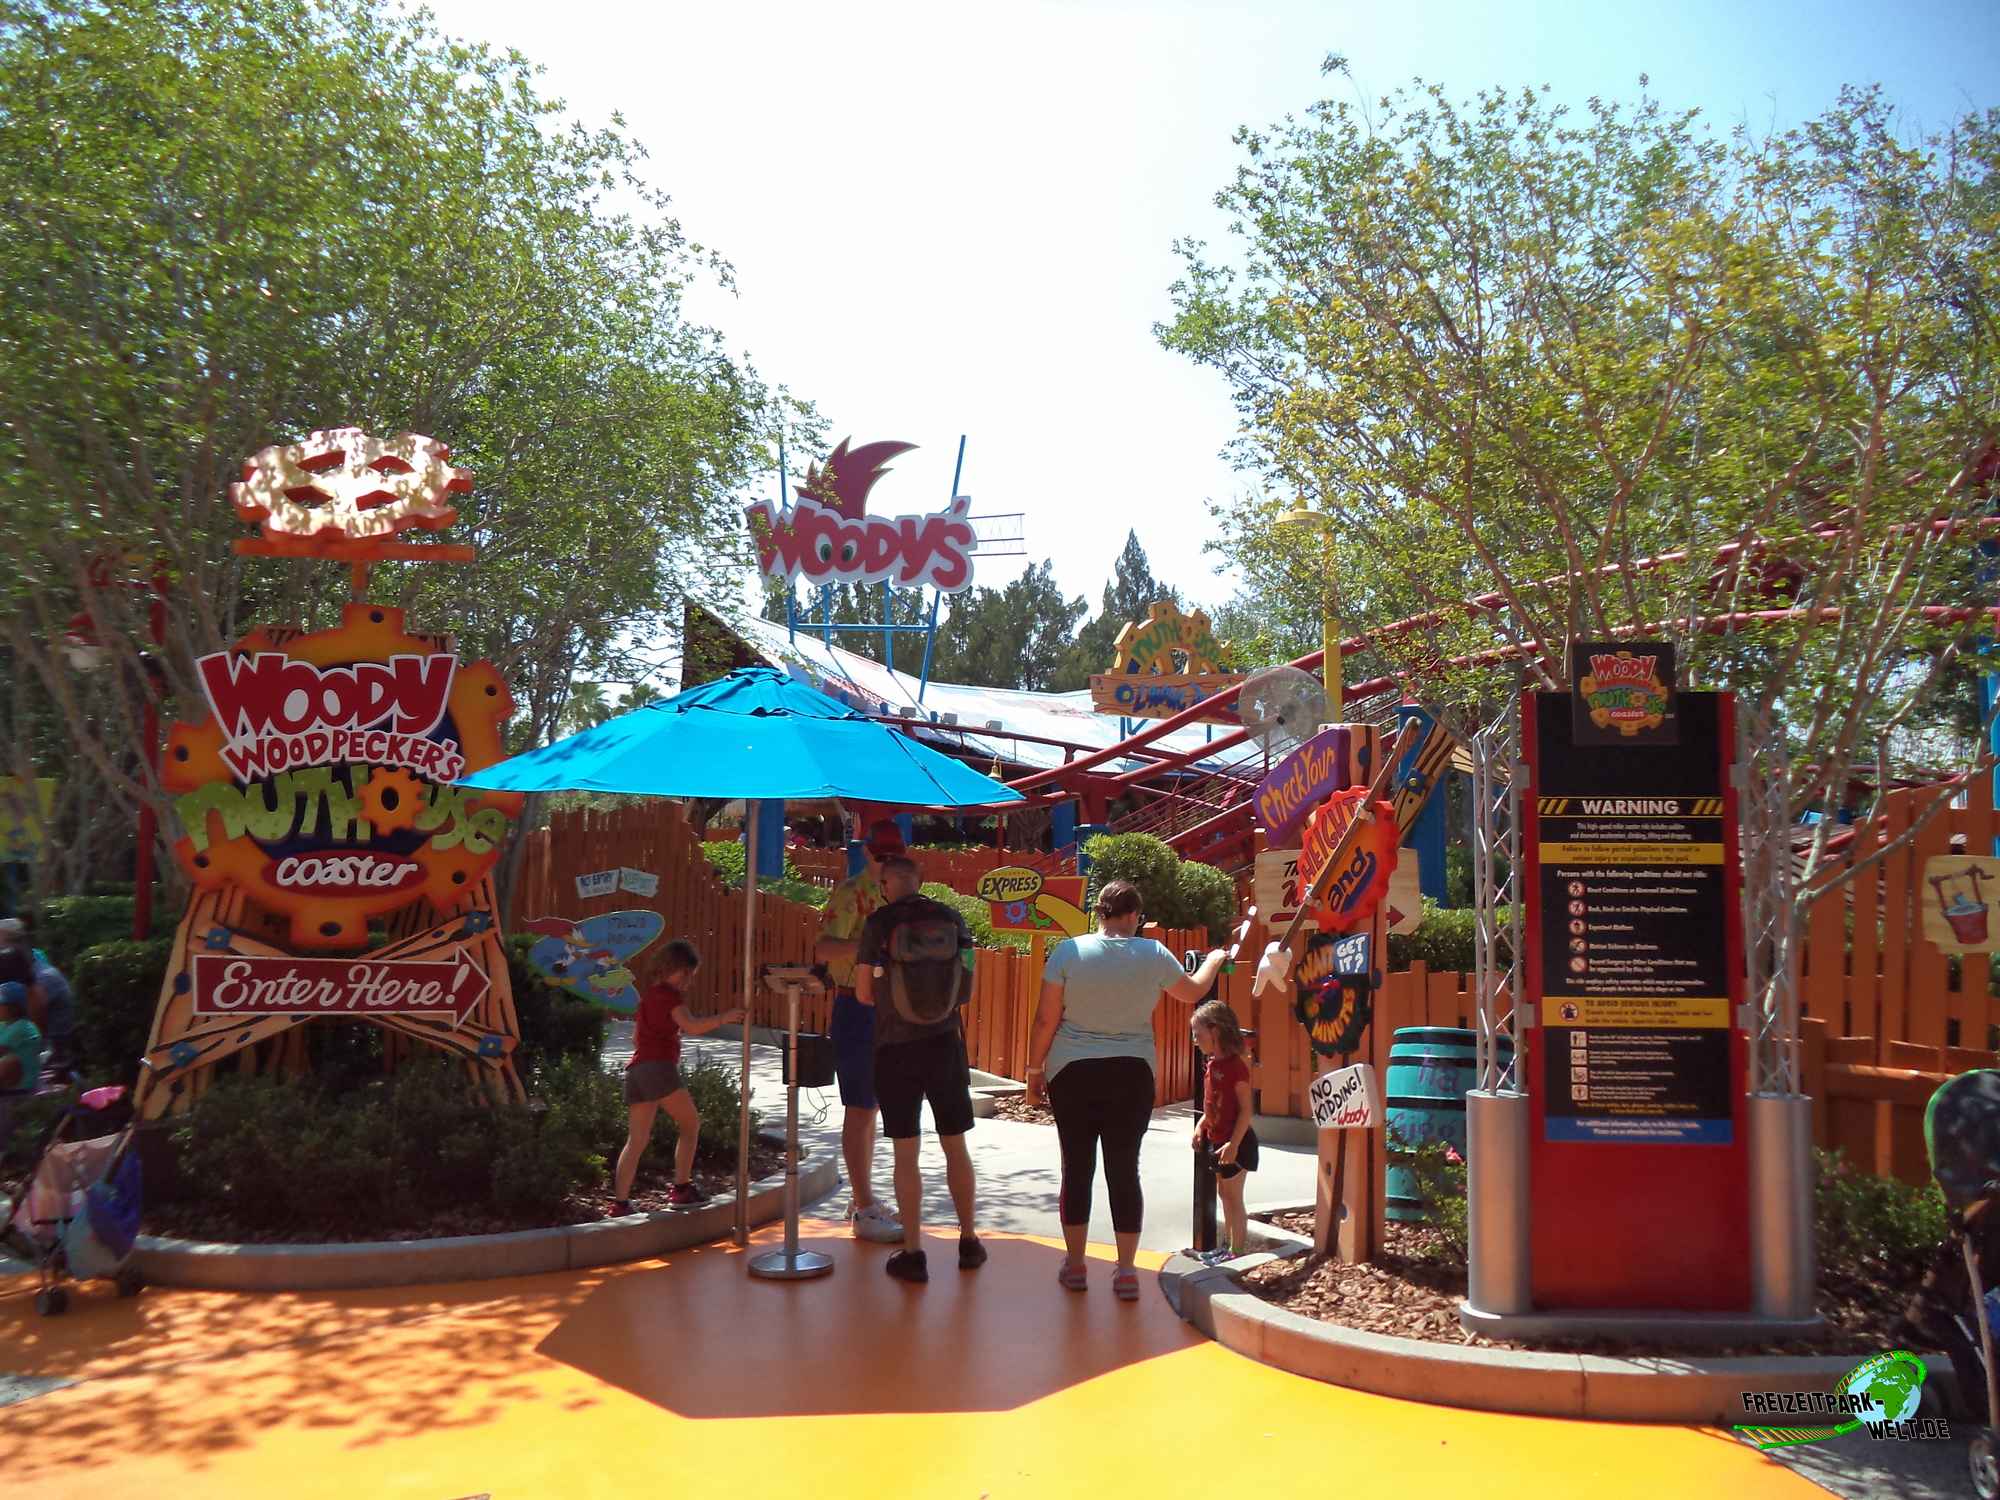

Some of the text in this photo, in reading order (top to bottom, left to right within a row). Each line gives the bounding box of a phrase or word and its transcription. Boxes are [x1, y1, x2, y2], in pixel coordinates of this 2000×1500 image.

[743, 495, 977, 593] WOODY'S
[1590, 655, 1656, 681] WOODY
[195, 651, 458, 739] WOODY
[219, 729, 465, 784] WOODPECKER'S
[1260, 744, 1335, 830] Check Your
[1582, 800, 1679, 815] WARNING
[276, 856, 418, 887] coaster
[981, 875, 1038, 900] EXPRESS
[1328, 846, 1367, 912] and
[1336, 935, 1366, 958] GET
[1338, 953, 1364, 973] IT?
[212, 961, 470, 1010] Enter Here!
[1311, 1079, 1332, 1104] NO
[1314, 1066, 1364, 1126] KIDDING!
